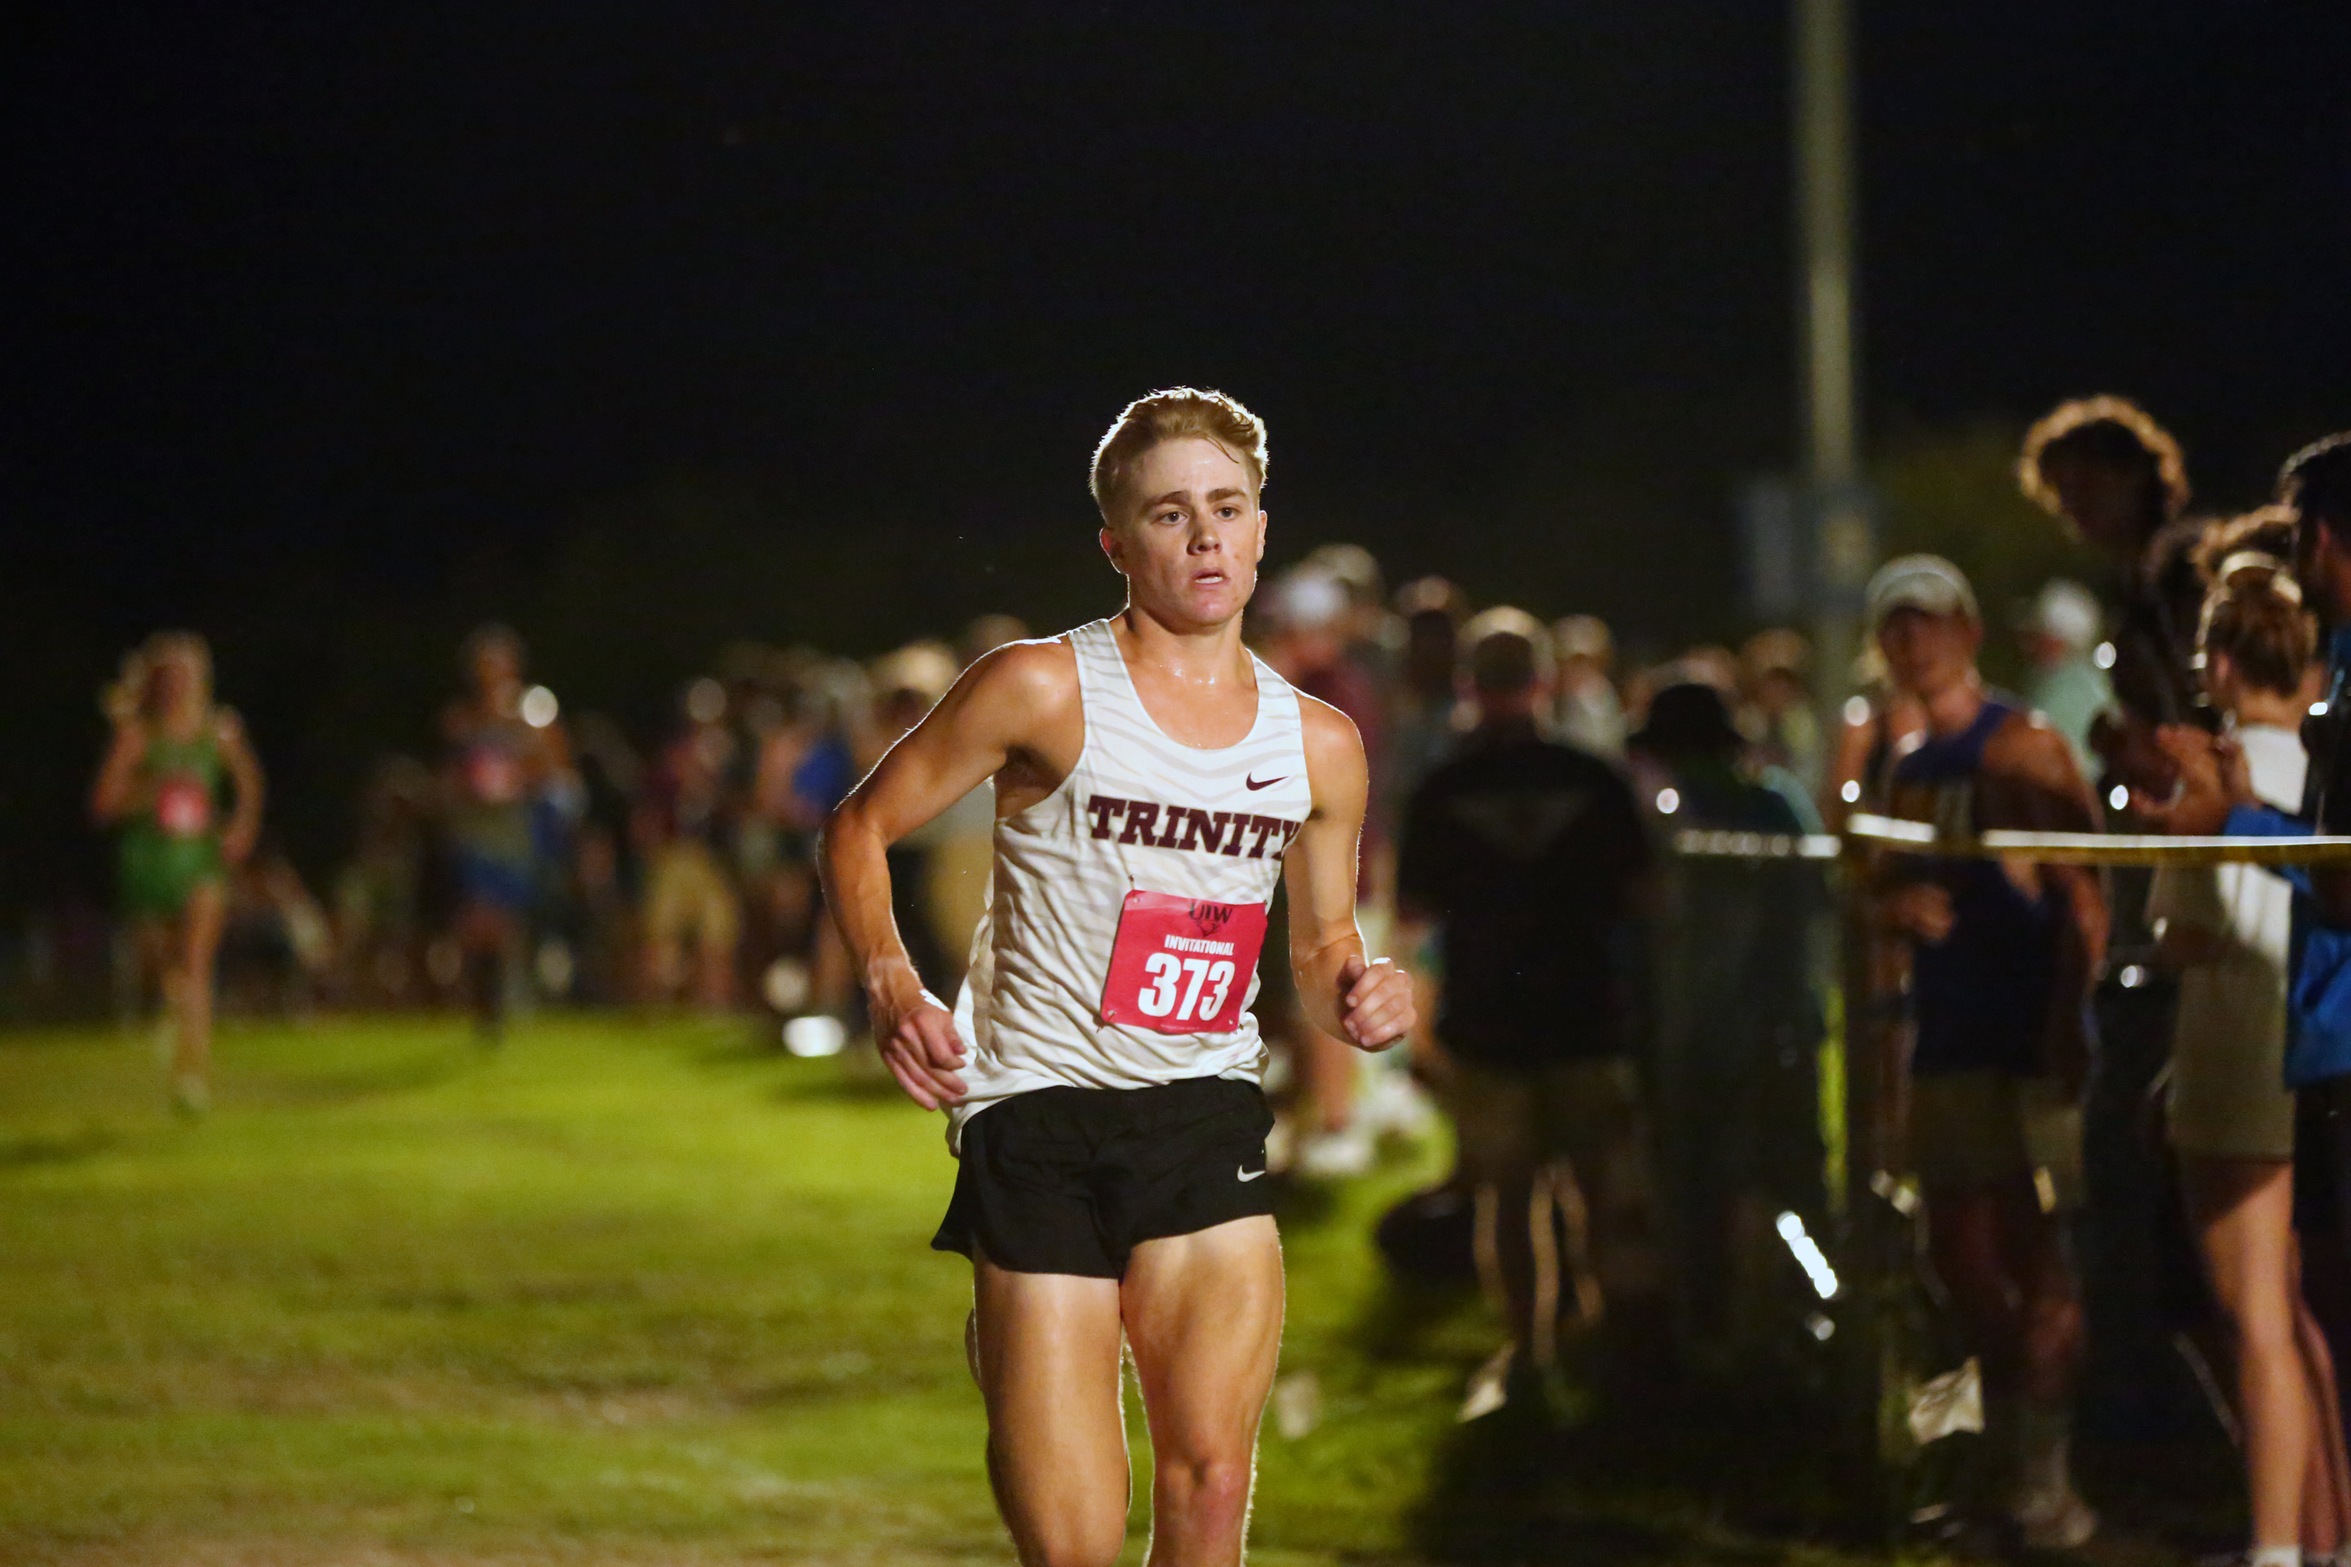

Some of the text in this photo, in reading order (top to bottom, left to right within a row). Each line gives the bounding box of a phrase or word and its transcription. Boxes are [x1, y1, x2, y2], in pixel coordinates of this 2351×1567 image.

[1189, 902, 1233, 924] UIW
[1164, 934, 1235, 956] INVITATIONAL
[1137, 952, 1236, 1021] 373
